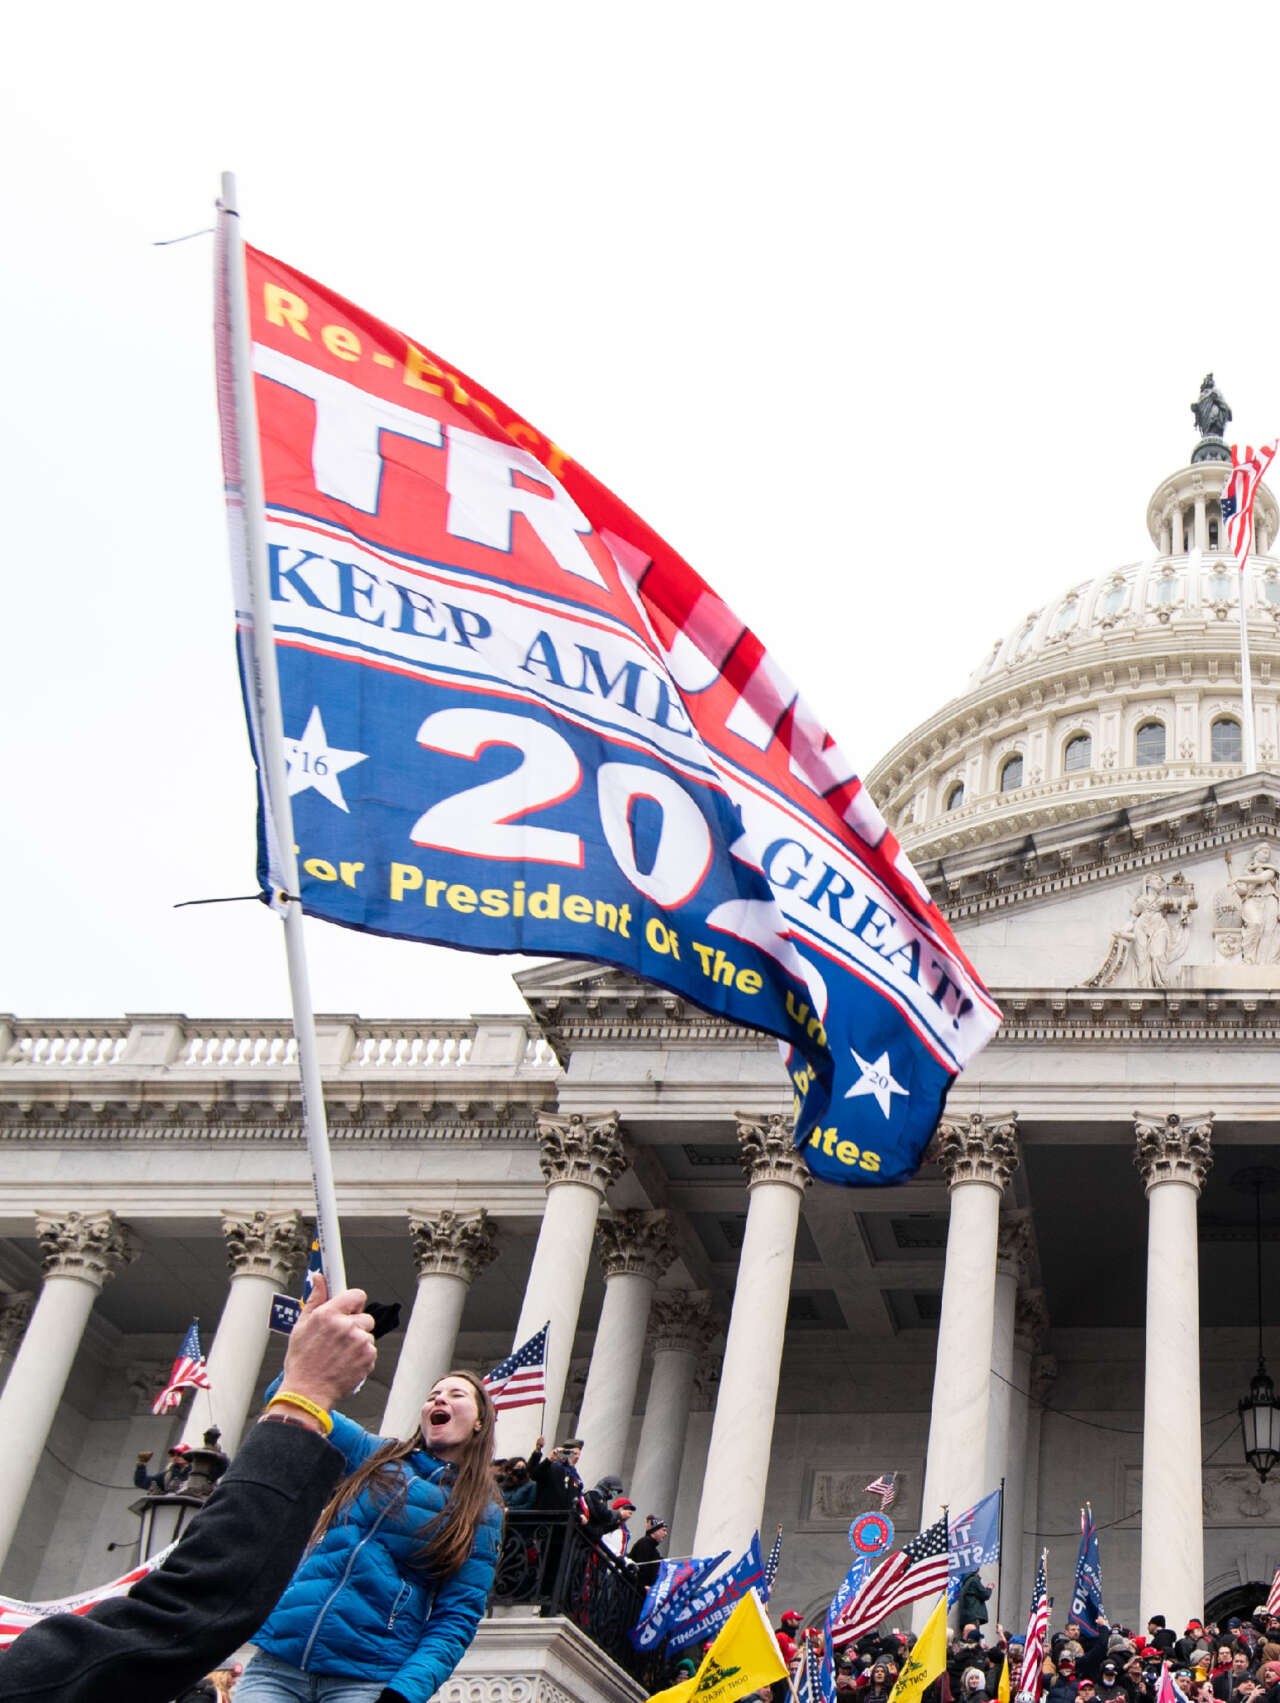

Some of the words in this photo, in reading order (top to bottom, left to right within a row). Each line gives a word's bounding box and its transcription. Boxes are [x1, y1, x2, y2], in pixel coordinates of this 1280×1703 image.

[269, 543, 492, 654] KEEP
[761, 837, 975, 1030] GREAT!
[294, 845, 364, 888] or
[390, 862, 631, 938] President
[646, 917, 680, 961] Of
[693, 941, 763, 995] The
